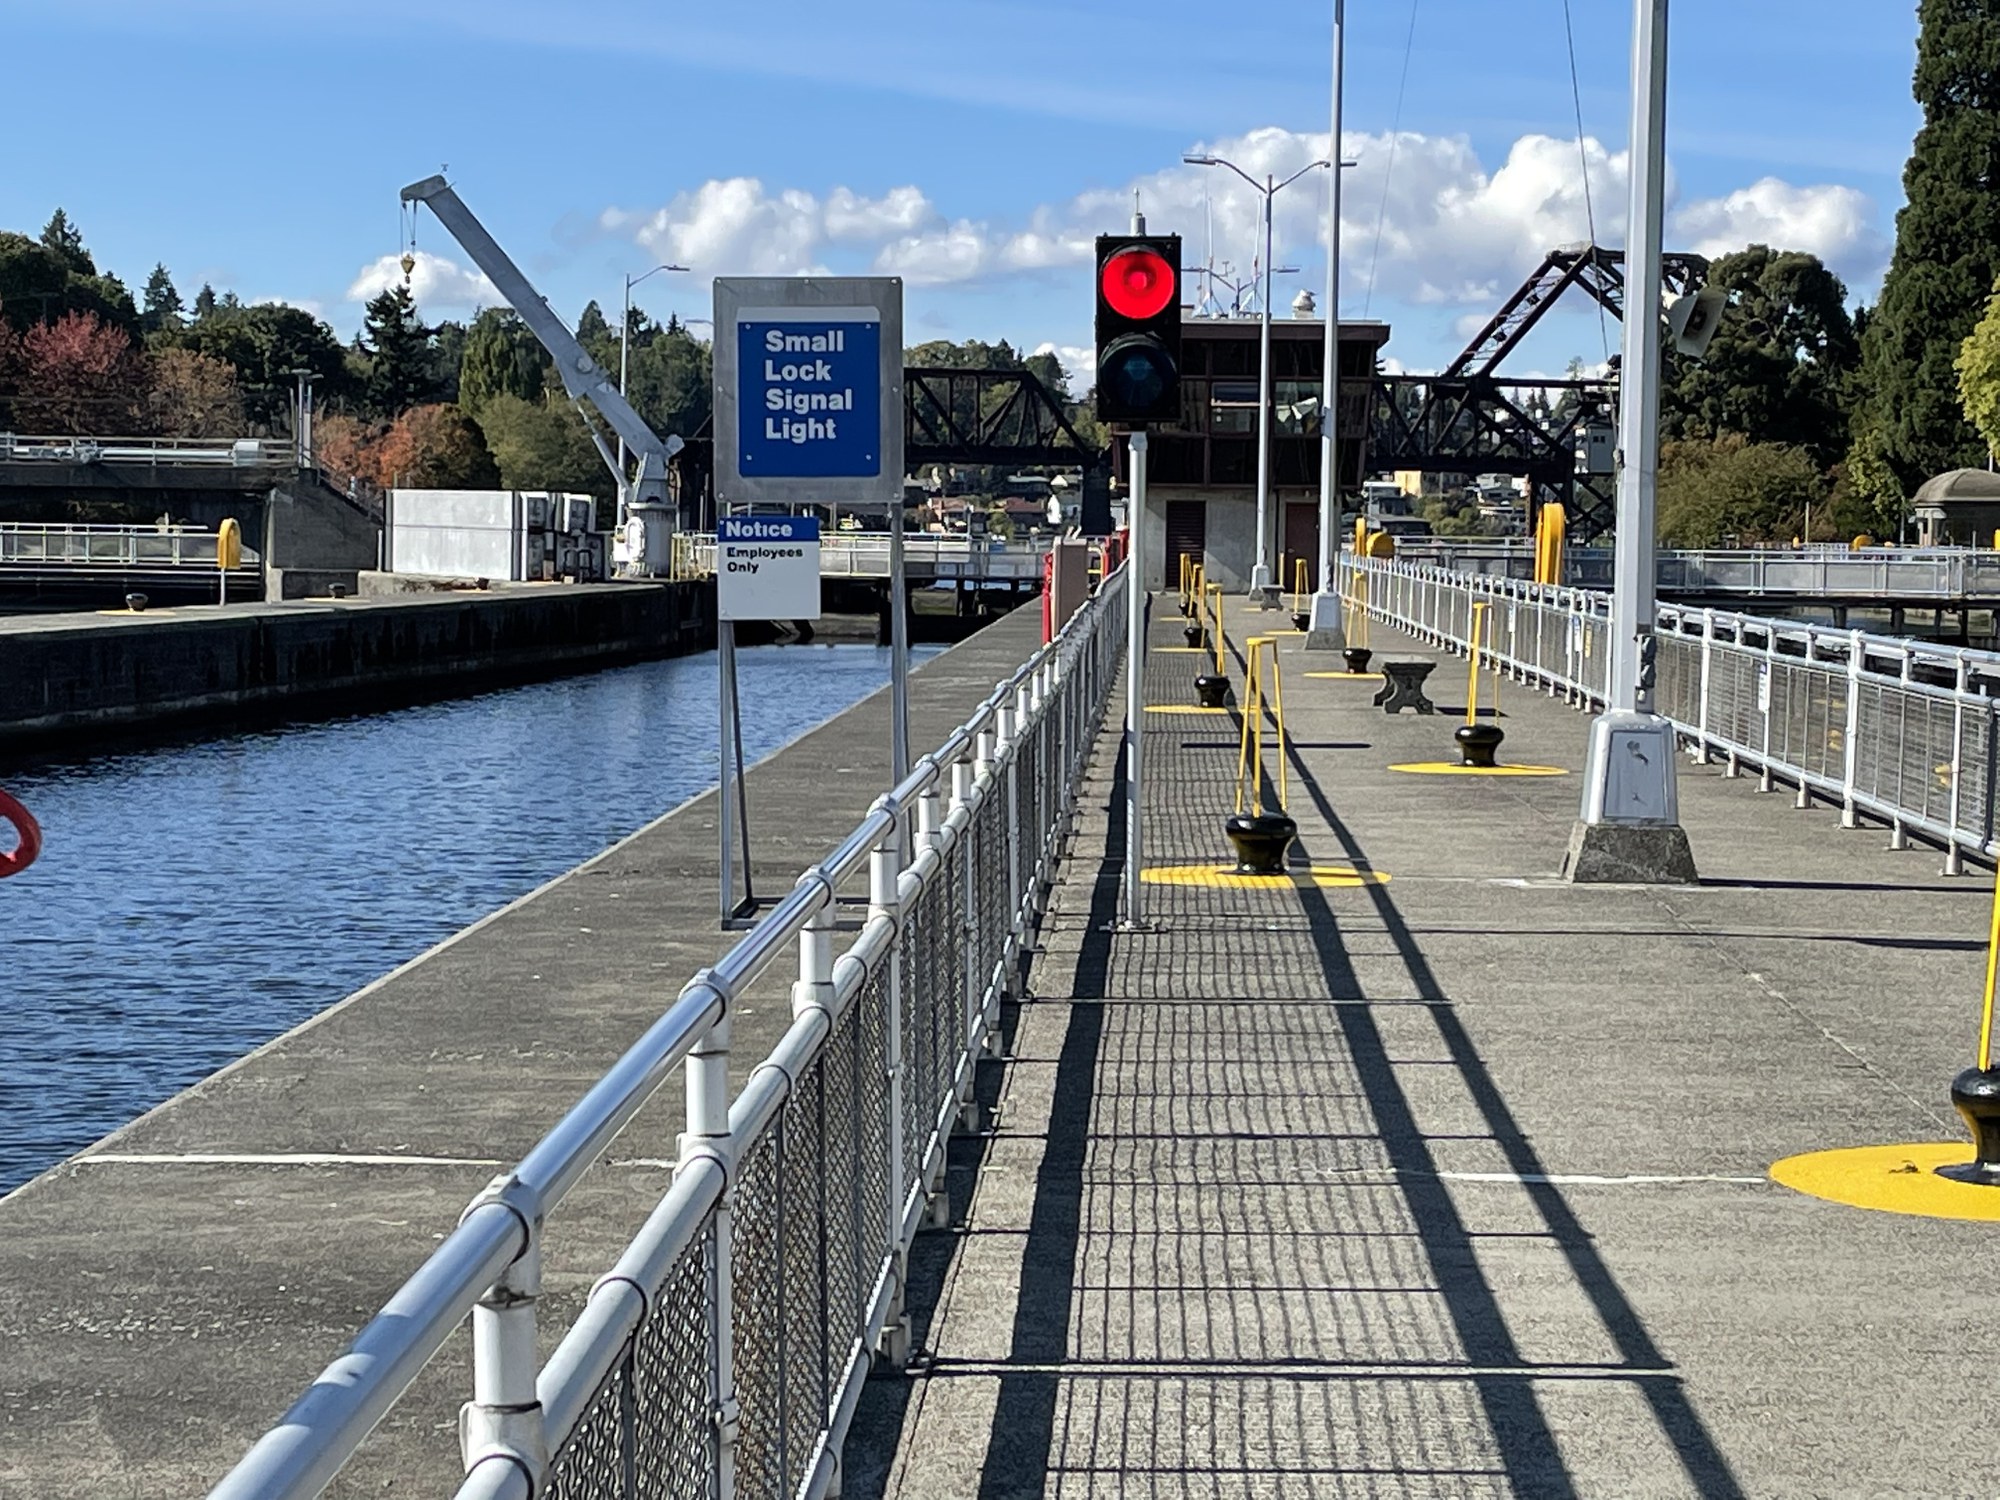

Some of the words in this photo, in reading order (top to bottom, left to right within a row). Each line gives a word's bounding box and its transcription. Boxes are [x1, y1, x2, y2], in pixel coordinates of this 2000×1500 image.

[765, 330, 844, 351] Small
[765, 359, 832, 381] Lock
[765, 388, 852, 414] Signal
[765, 418, 837, 443] Light
[726, 520, 793, 537] Notice
[726, 546, 804, 560] Employees
[727, 561, 760, 574] Only
